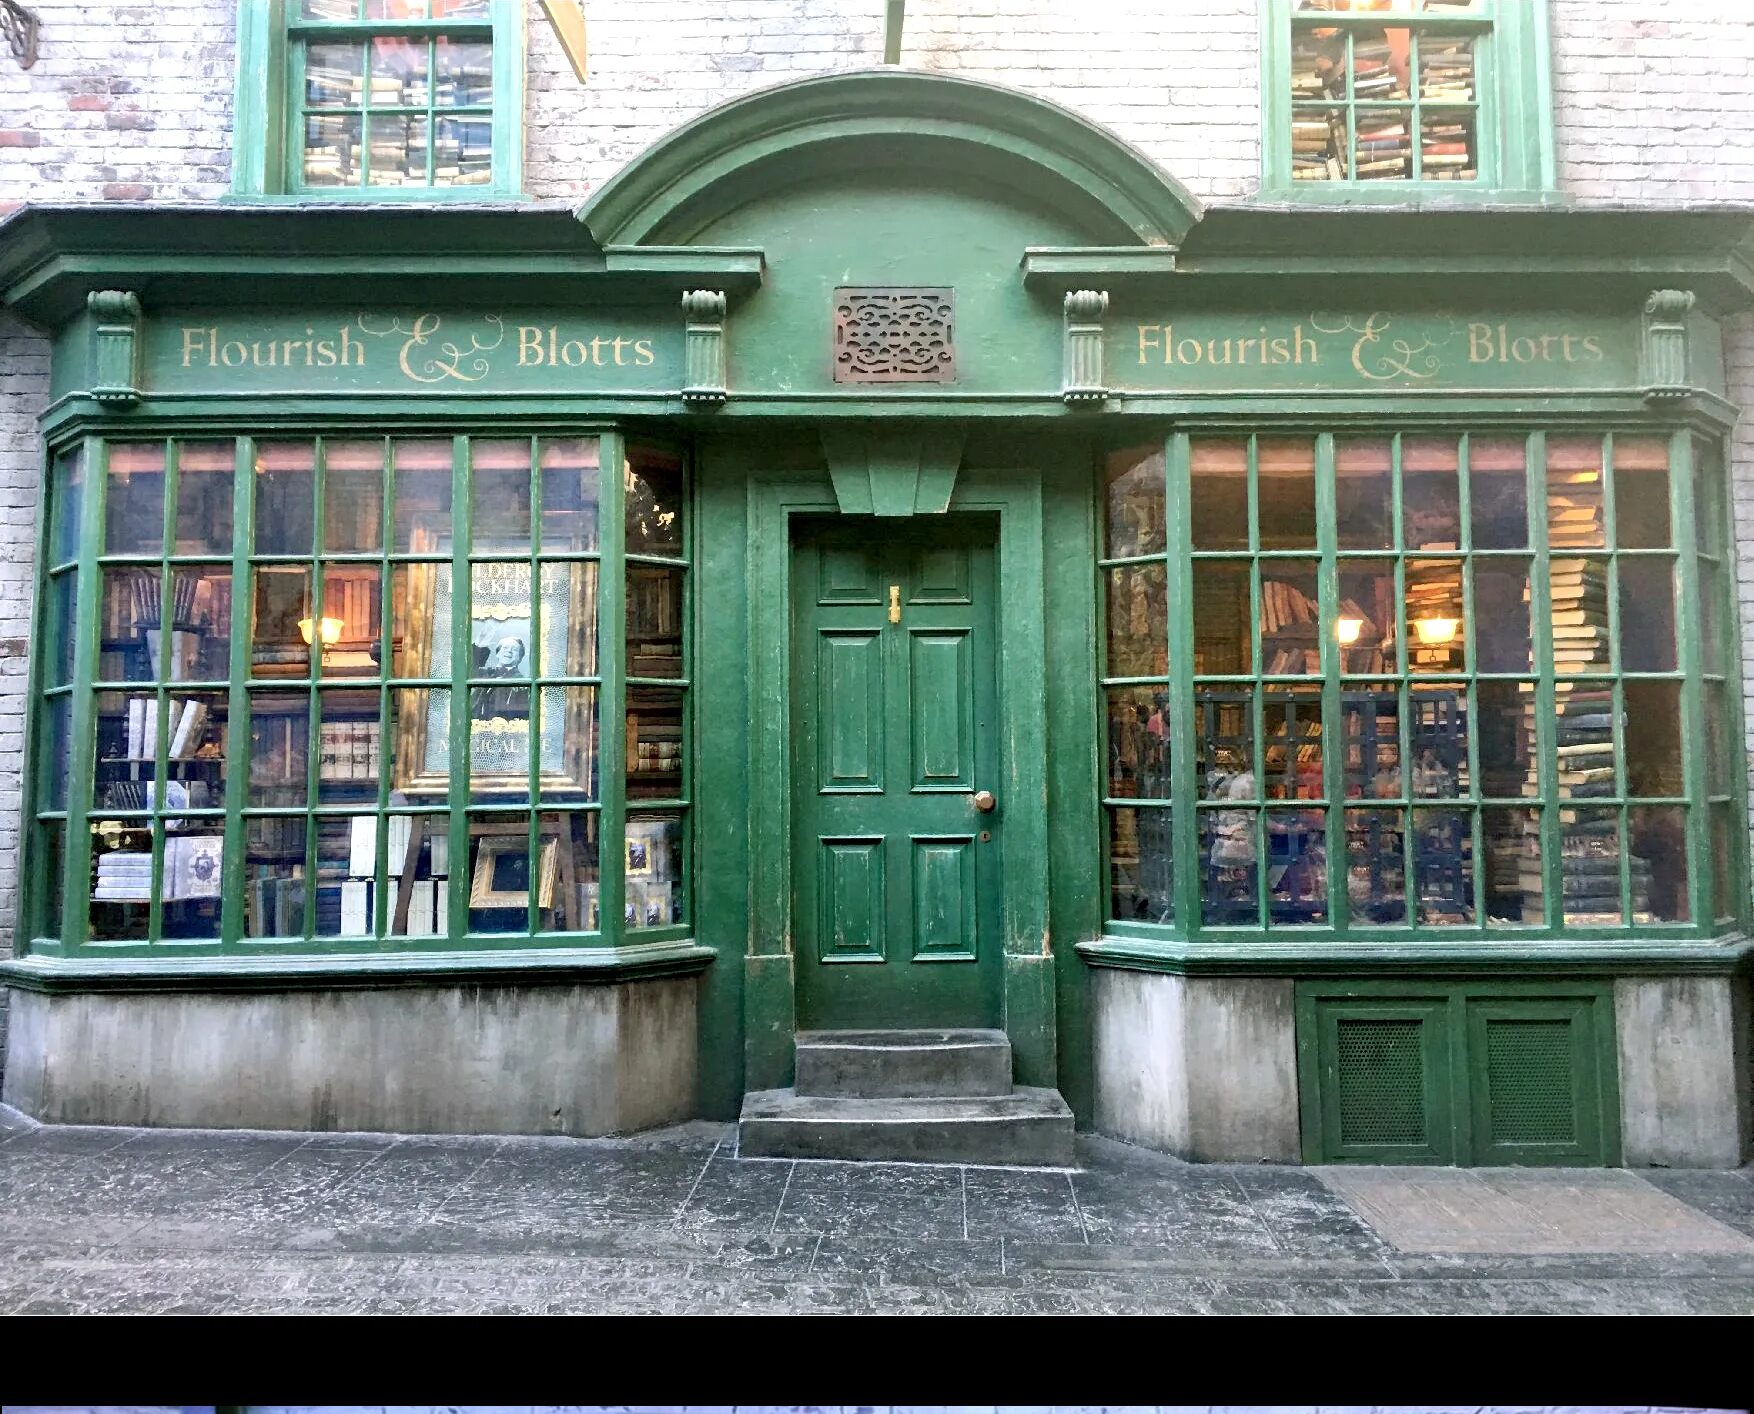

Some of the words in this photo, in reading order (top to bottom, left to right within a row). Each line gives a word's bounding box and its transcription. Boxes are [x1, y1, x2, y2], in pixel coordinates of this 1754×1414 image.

[180, 326, 366, 367] Flourish
[357, 313, 503, 383] &
[516, 324, 655, 367] Blotts
[1137, 324, 1318, 366] Flourish
[1310, 310, 1452, 381] &
[1468, 322, 1604, 364] Blotts
